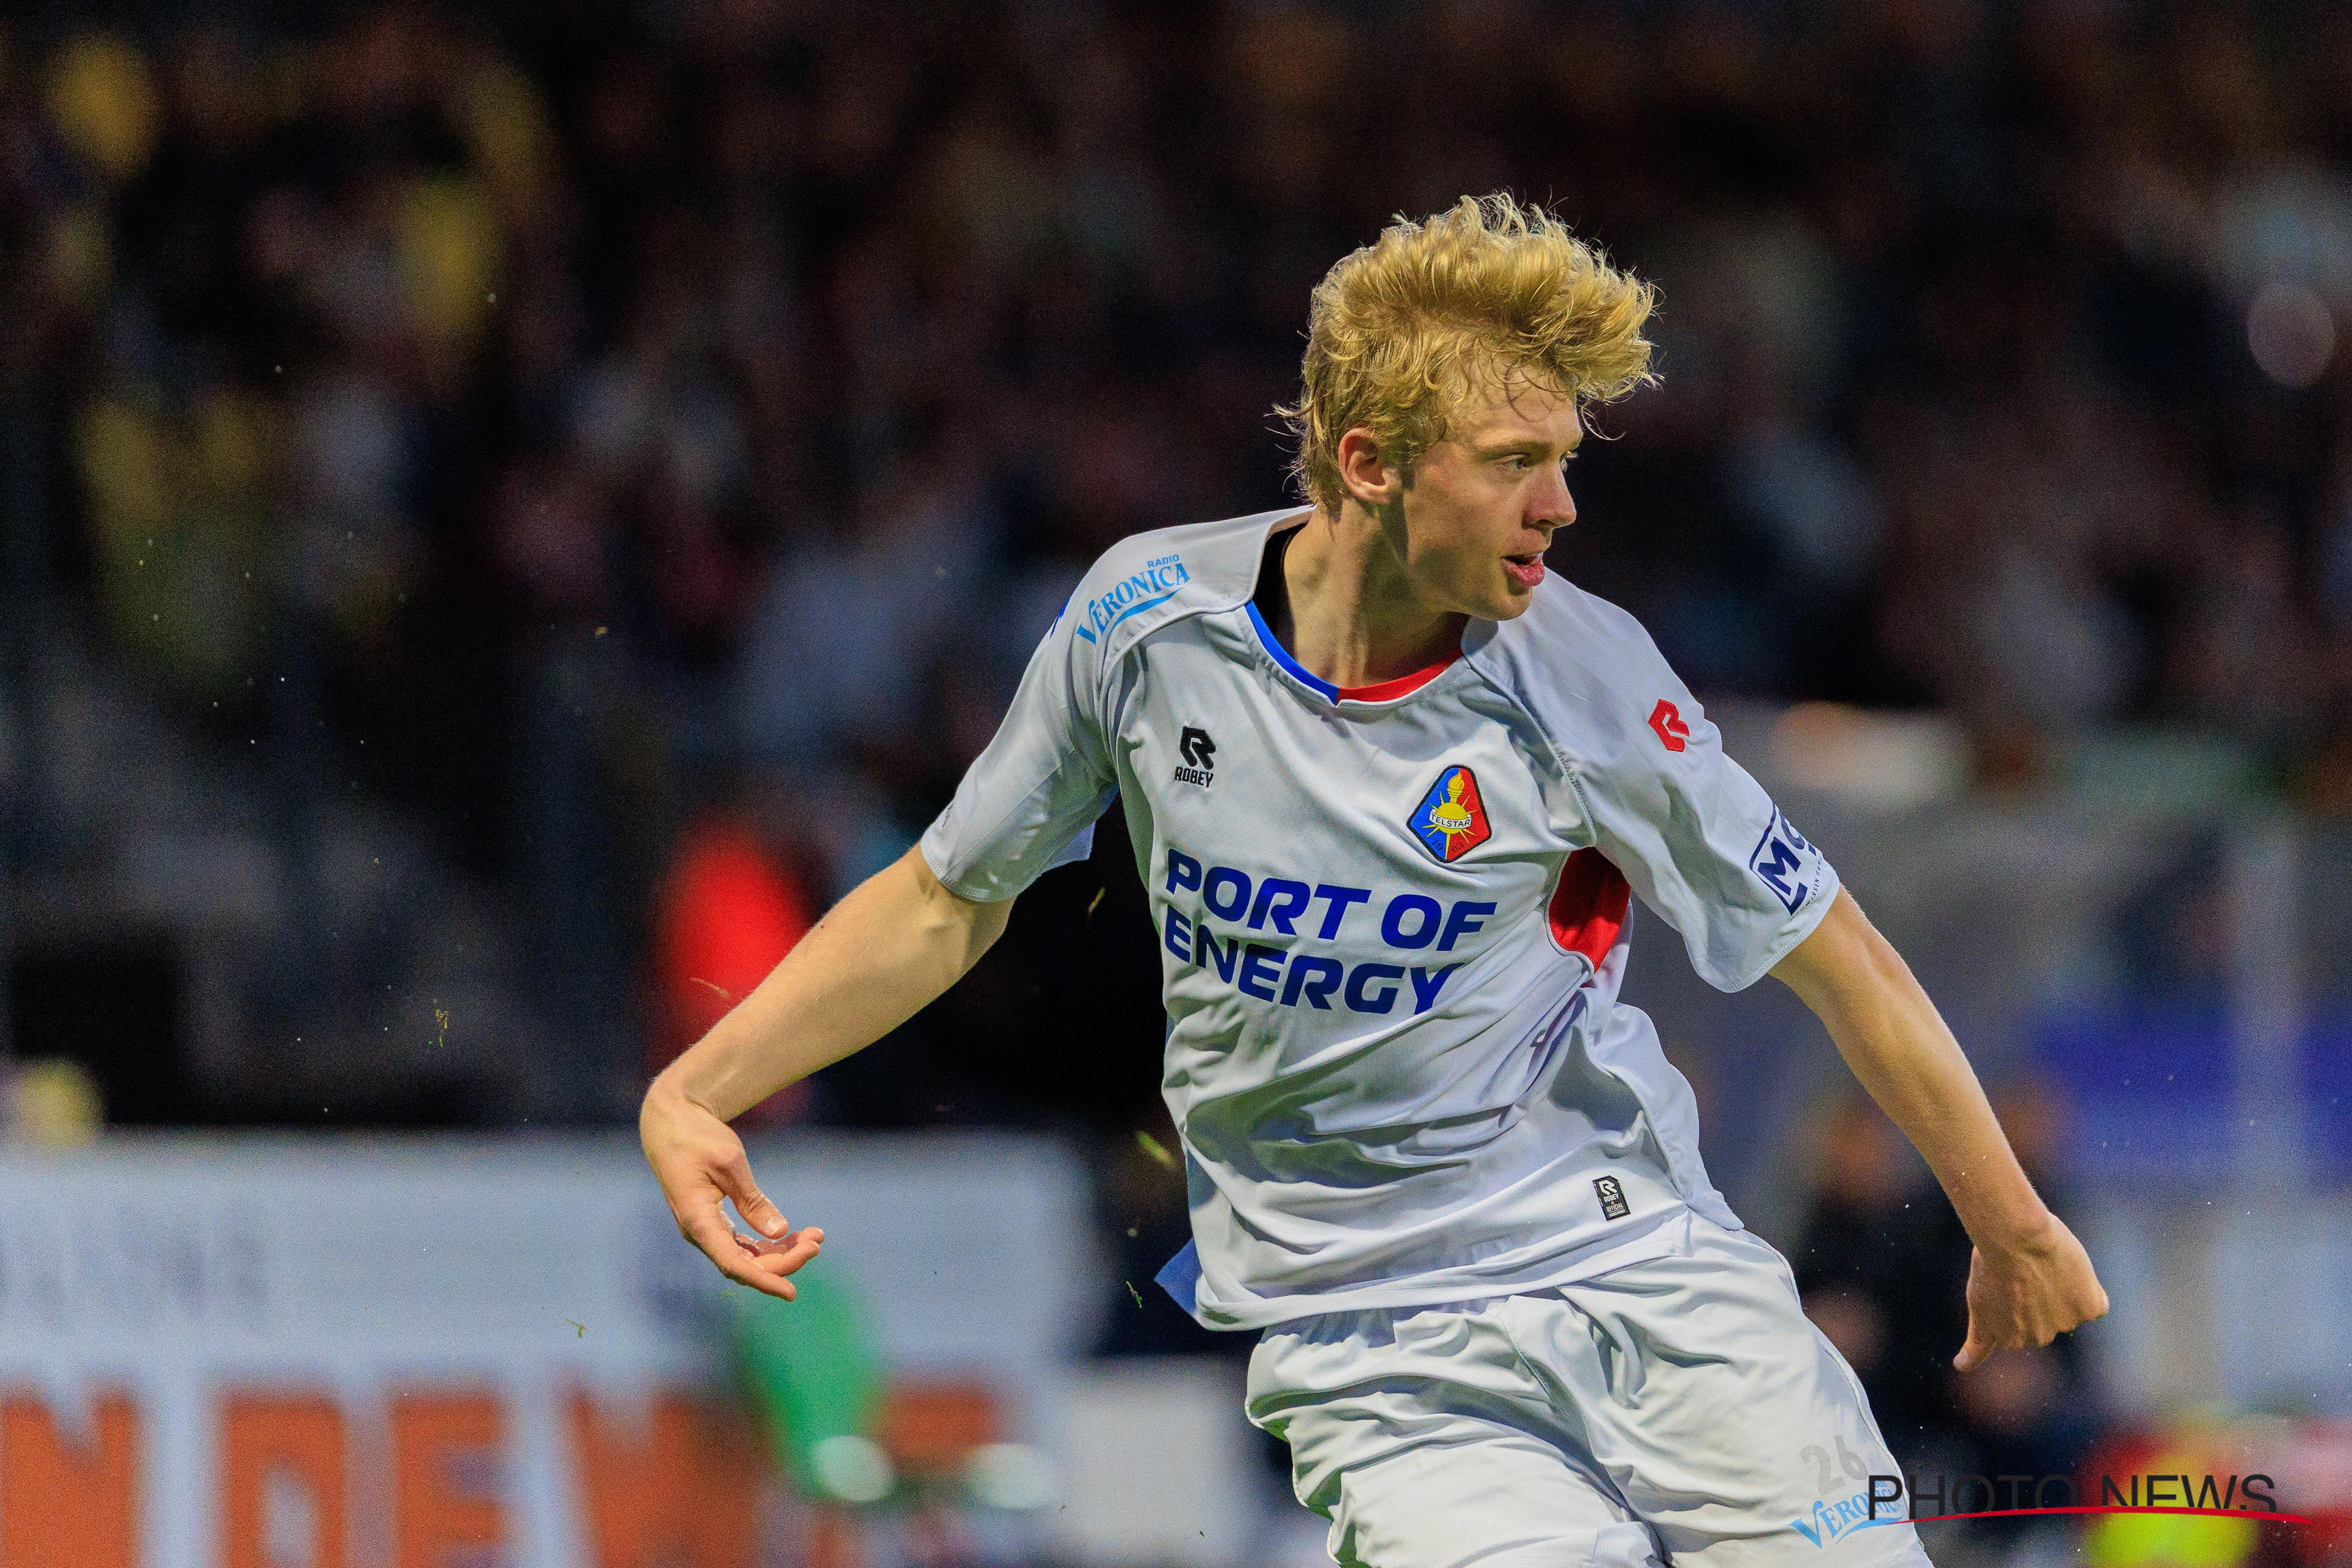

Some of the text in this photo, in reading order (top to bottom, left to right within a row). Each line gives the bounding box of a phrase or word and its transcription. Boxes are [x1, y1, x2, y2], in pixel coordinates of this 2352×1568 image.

[1147, 554, 1180, 568] RADIO
[1076, 563, 1191, 645] VERONICA
[1174, 766, 1214, 788] ROBEY
[1430, 813, 1471, 827] TELSTAR
[1166, 848, 1498, 951] PORT OF
[1165, 904, 1470, 1015] ENERGY
[1603, 1193, 1619, 1202] ROBEY
[1606, 1202, 1624, 1212] OFFICIAL
[1800, 1434, 1868, 1496] 26
